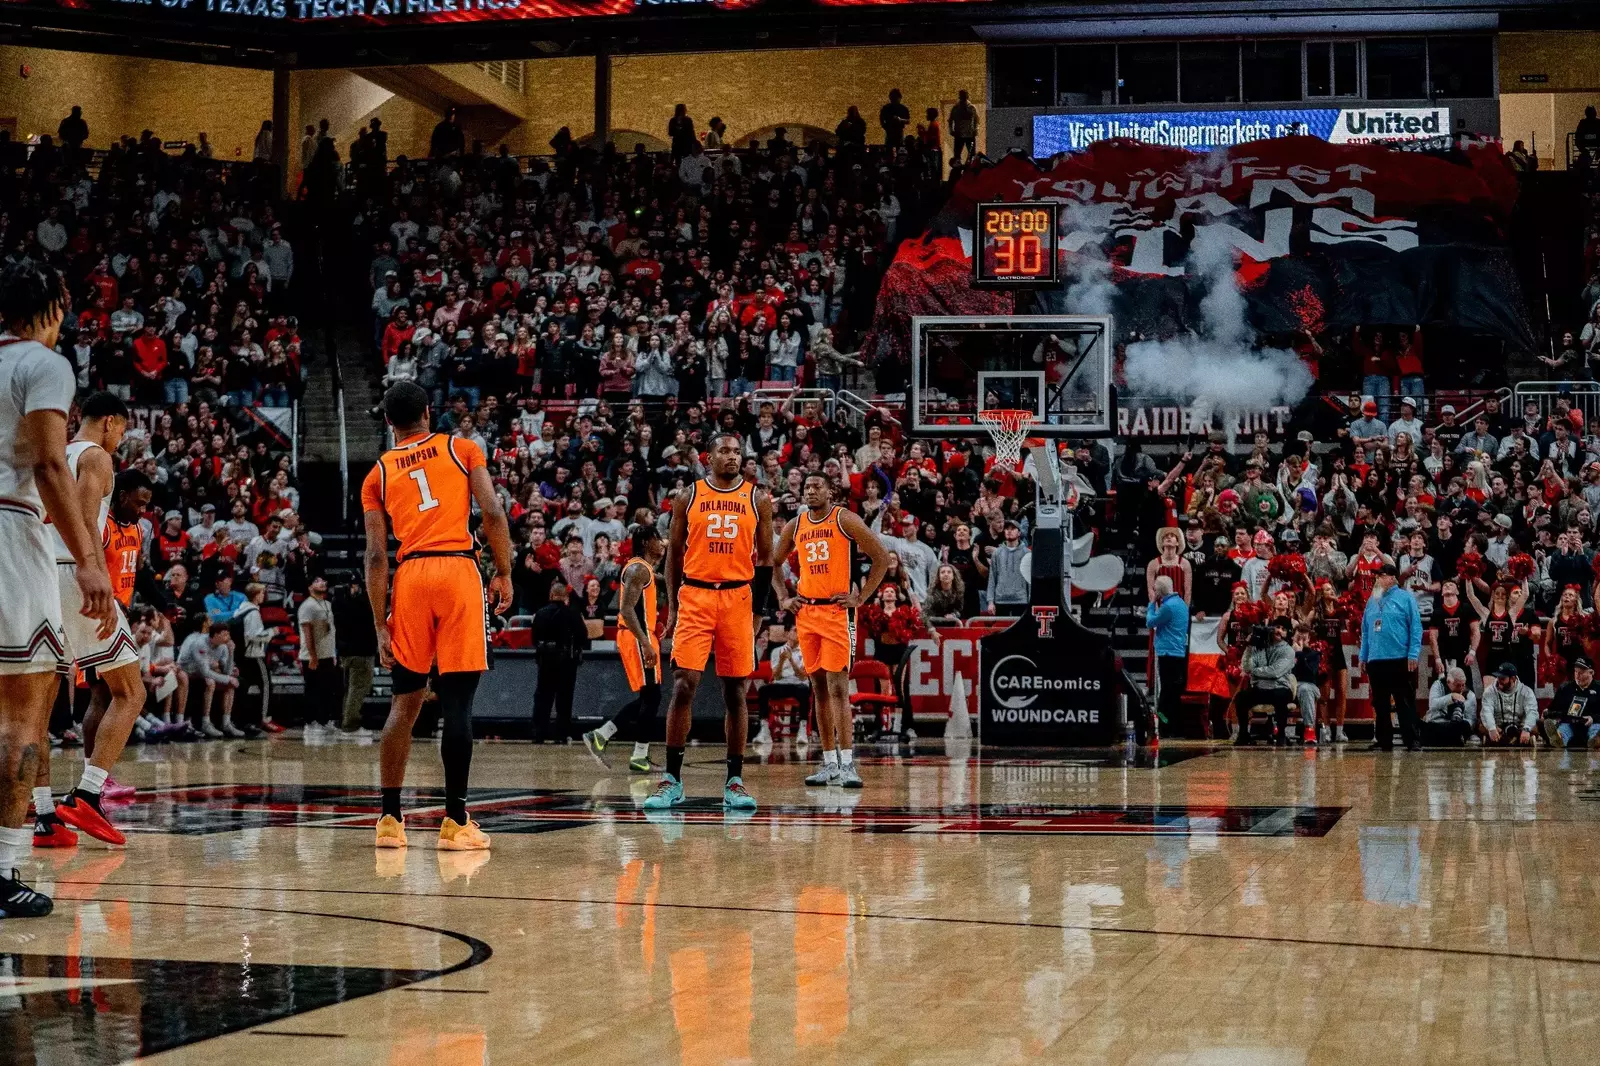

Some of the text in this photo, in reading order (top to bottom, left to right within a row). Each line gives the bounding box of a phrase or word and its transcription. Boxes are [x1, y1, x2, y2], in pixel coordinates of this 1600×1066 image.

[294, 0, 365, 18] TECH
[1069, 118, 1309, 148] Visit UnitedSupermarketscm
[1346, 111, 1440, 134] United
[986, 211, 1048, 233] 20:00
[994, 236, 1041, 273] 30
[395, 446, 439, 469] THOMPSON
[409, 468, 440, 512] 1
[700, 500, 747, 515] OKLAHOMA
[706, 513, 739, 539] 25
[800, 528, 834, 543] OKLAHOMA
[709, 541, 734, 555] STATE
[805, 540, 830, 562] 33
[121, 550, 136, 574] 14
[809, 564, 829, 575] STATE
[996, 675, 1101, 691] CAREnomics
[991, 708, 1100, 724] WOUNDCARE
